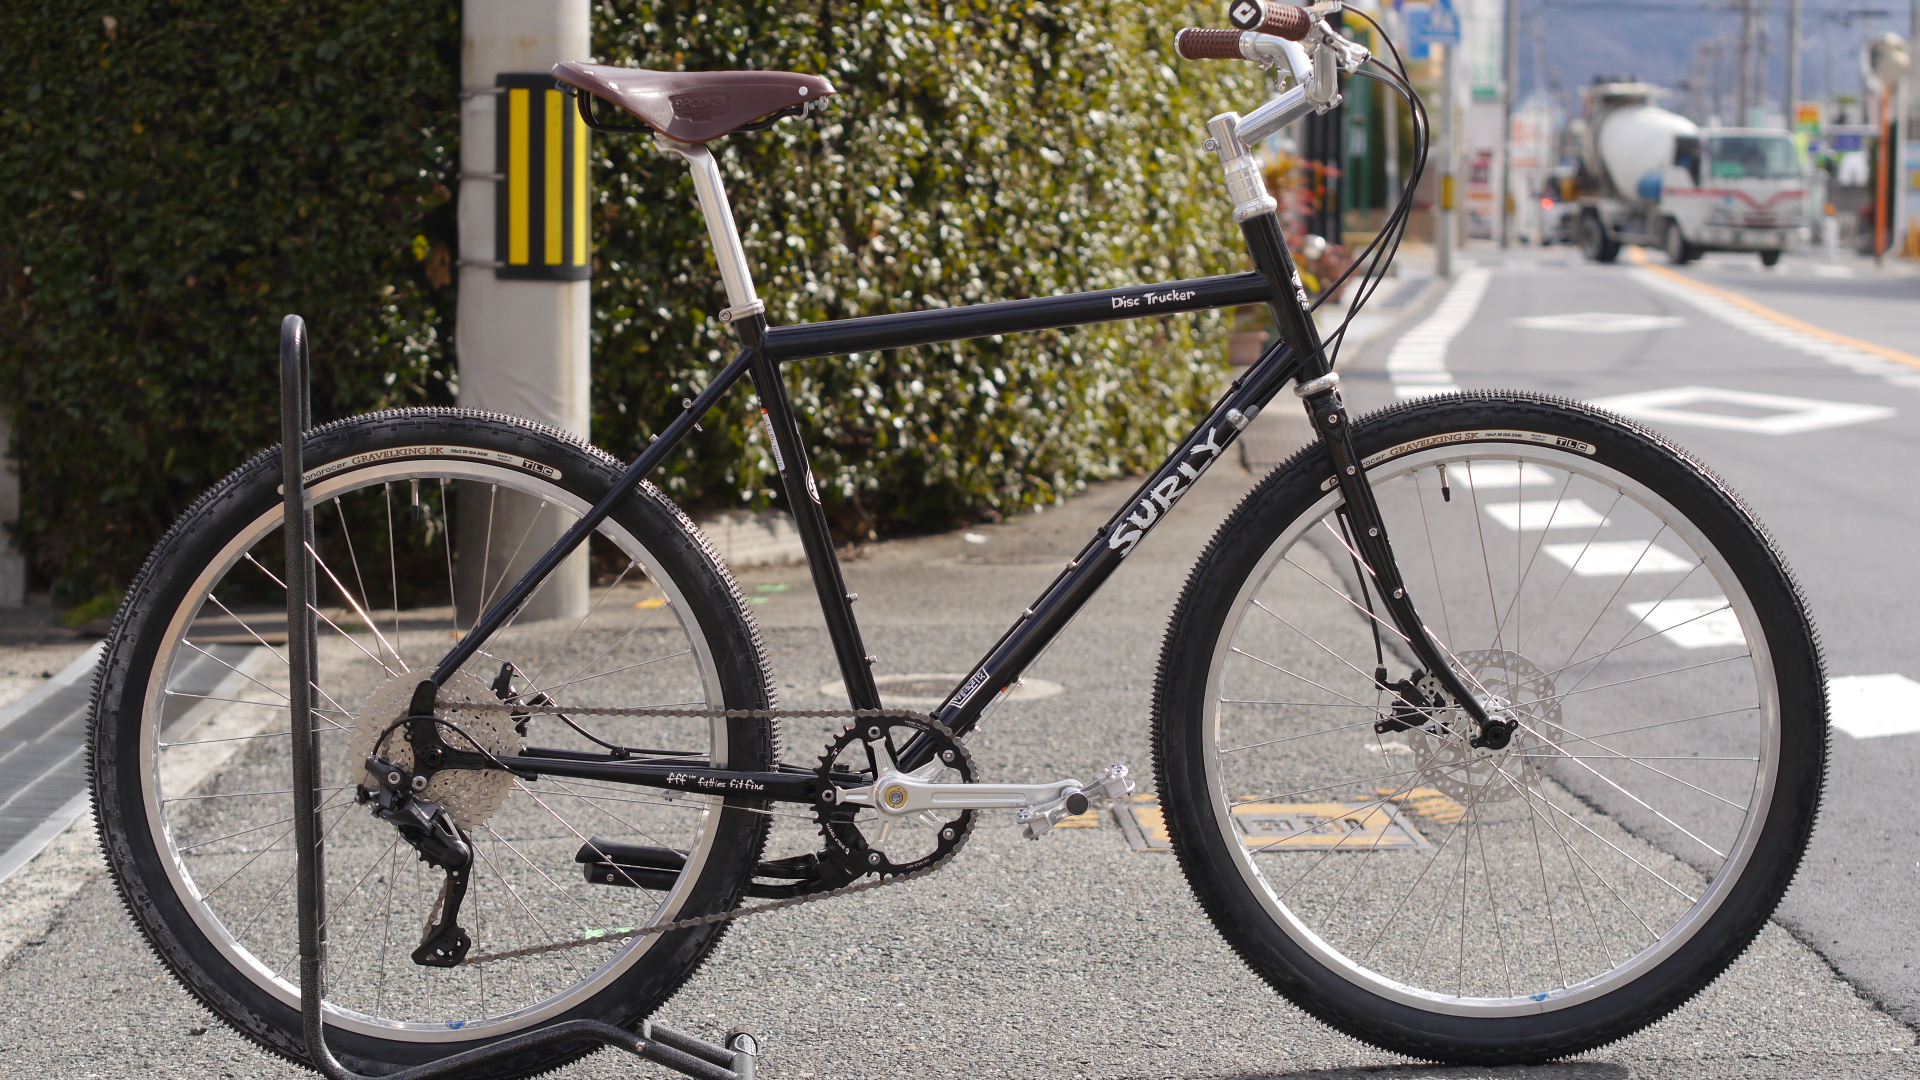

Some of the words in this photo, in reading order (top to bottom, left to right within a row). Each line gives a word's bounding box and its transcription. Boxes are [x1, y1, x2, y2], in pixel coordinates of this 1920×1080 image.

[674, 96, 725, 110] BROOKS
[1111, 296, 1140, 309] Disc
[1143, 289, 1196, 305] Trucker
[1390, 434, 1462, 456] GRAVELKING
[1465, 432, 1479, 440] SK
[1556, 437, 1588, 452] TLC
[351, 447, 427, 464] GRAVELKING
[429, 447, 444, 455] SK
[522, 459, 554, 476] TLC
[1108, 426, 1222, 559] SURLY
[825, 822, 838, 840] TOOTH
